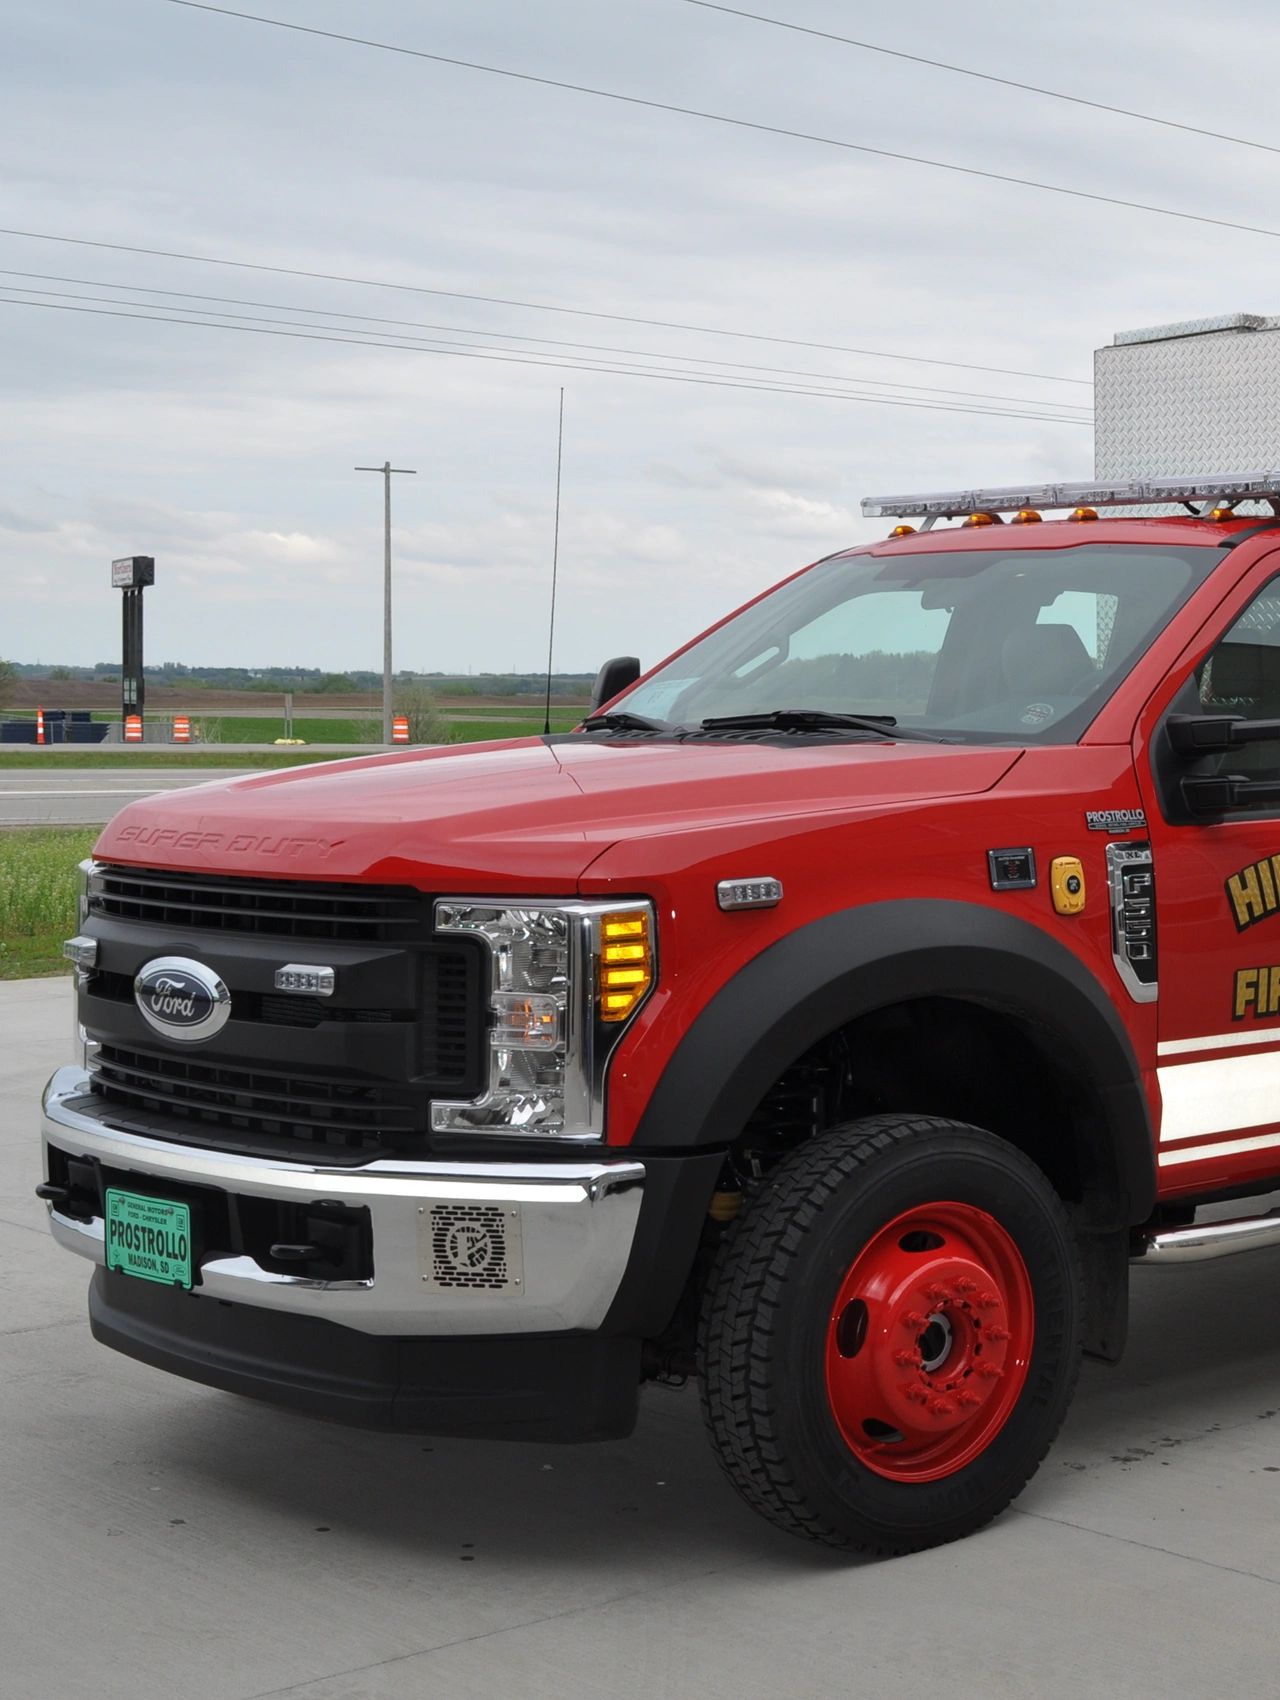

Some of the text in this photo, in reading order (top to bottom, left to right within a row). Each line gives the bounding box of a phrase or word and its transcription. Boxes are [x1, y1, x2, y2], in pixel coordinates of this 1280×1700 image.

[1086, 809, 1145, 822] PROSTROLLO
[115, 825, 347, 859] SUPER DUTY
[1127, 851, 1140, 859] XL
[150, 977, 196, 1017] Ford
[127, 1202, 146, 1212] GENERAL
[147, 1207, 169, 1216] MOTORS
[128, 1211, 140, 1220] FORD
[142, 1214, 167, 1225] CHRYSLER
[110, 1218, 187, 1262] PROSTROLLO
[160, 1260, 170, 1274] SD
